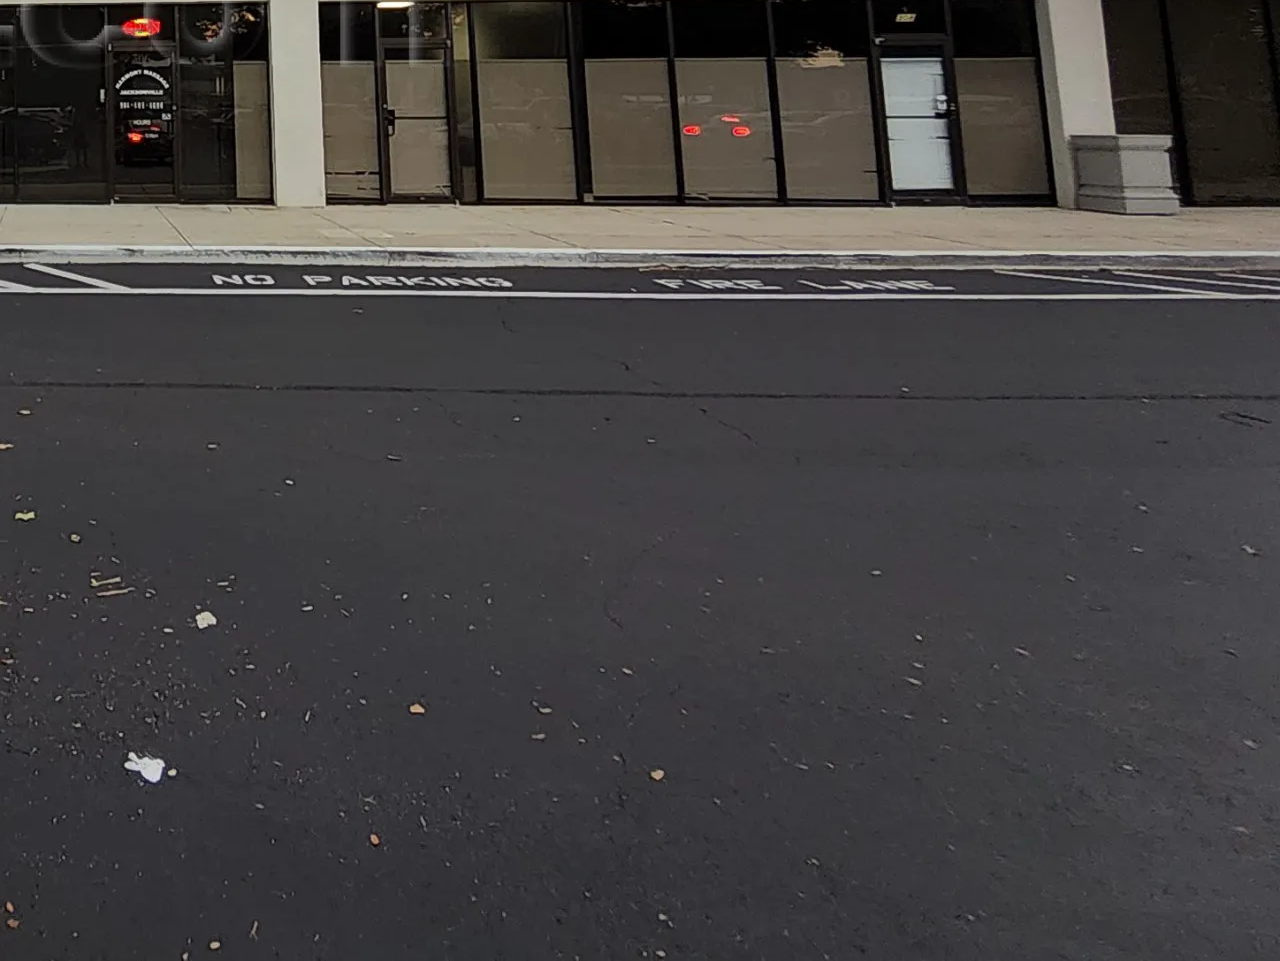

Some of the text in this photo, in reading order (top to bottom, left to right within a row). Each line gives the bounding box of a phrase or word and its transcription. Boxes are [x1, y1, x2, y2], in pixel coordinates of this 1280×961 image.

[211, 274, 514, 288] NO PARKING
[651, 278, 956, 290] FIRE LANE
